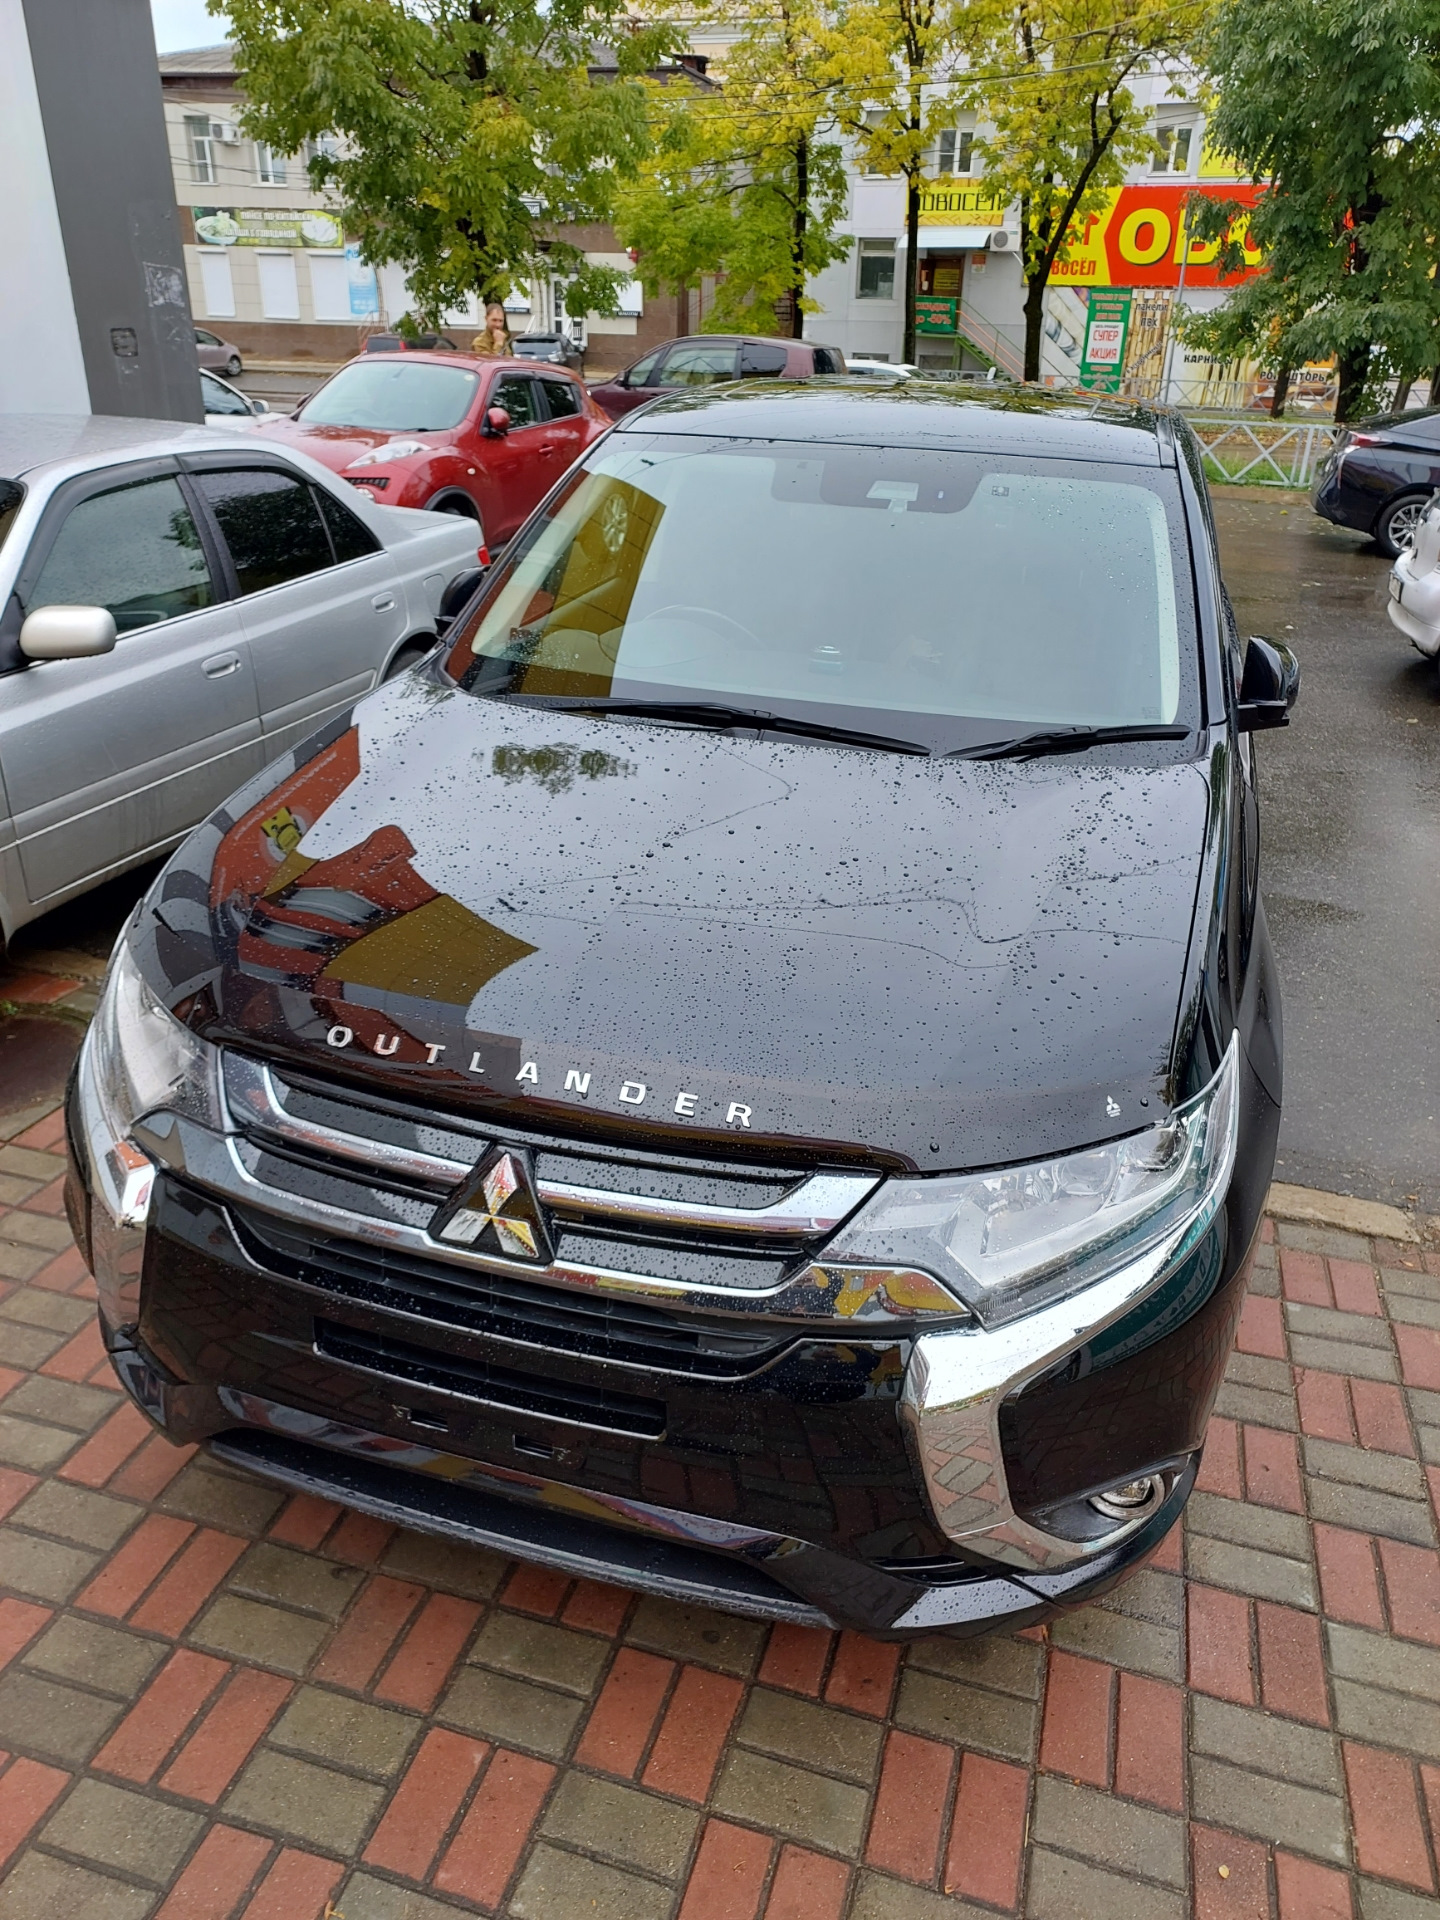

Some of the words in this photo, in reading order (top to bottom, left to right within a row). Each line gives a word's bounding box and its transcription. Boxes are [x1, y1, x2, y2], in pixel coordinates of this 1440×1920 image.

[1050, 257, 1096, 276] ВОСЁЛ
[1093, 330, 1119, 341] СУПЕР
[1089, 348, 1117, 360] АКЦИЯ
[1184, 354, 1233, 364] КАРНИЫ
[327, 1025, 753, 1128] OUTLANDER
